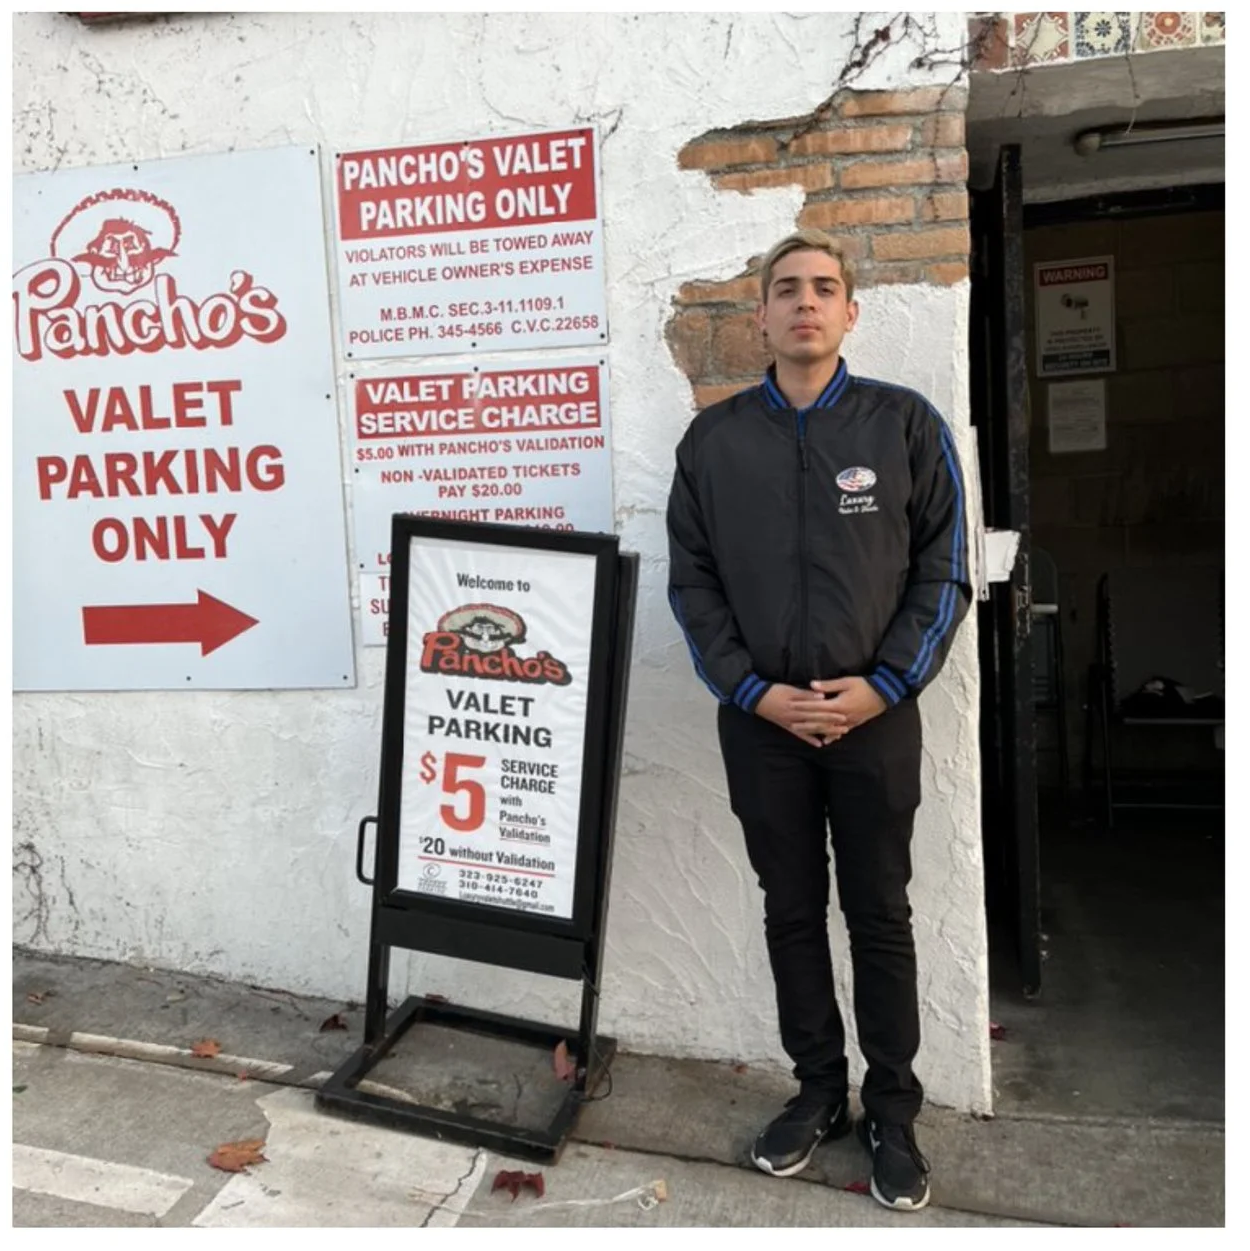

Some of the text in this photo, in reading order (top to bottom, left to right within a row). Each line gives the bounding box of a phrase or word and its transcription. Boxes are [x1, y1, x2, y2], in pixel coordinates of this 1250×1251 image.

[343, 137, 586, 191] PANCHO'S VALET
[360, 183, 573, 231] PARKING ONLY
[345, 231, 594, 264] VIOLATORS WILL BE TOWED AWAY
[349, 256, 593, 287] AT VEHICLE OWNER'S EXPENSE
[1042, 266, 1106, 284] WARNING
[13, 258, 287, 361] Pancho's
[380, 296, 565, 321] M.B.M.C. SEC.3-11.1109.1
[349, 315, 599, 344] POLICE PH. 345-4566 C.V.C.22658
[366, 372, 590, 404] VALET PARKING
[63, 380, 242, 433] VALET
[360, 402, 597, 434] SERVICE CHARGE
[357, 435, 605, 461] $5.00 WITH PANCHO'S VALIDATION
[37, 445, 285, 500] PARKING
[381, 470, 413, 483] NON
[513, 462, 581, 477] TICKETS
[438, 483, 522, 498] PAY $20.00
[495, 506, 565, 520] PARKING
[92, 513, 237, 563] ONLY
[457, 573, 530, 593] Welcome to
[420, 631, 573, 686] Pancho's
[446, 689, 535, 717] VALET
[428, 715, 552, 748] PARKING
[501, 759, 559, 778] SERVICE
[500, 775, 556, 794] CHARGE
[500, 795, 523, 807] with
[499, 811, 546, 826] Pancho's
[499, 827, 551, 843] Validation
[419, 836, 555, 871] $20 without Validation
